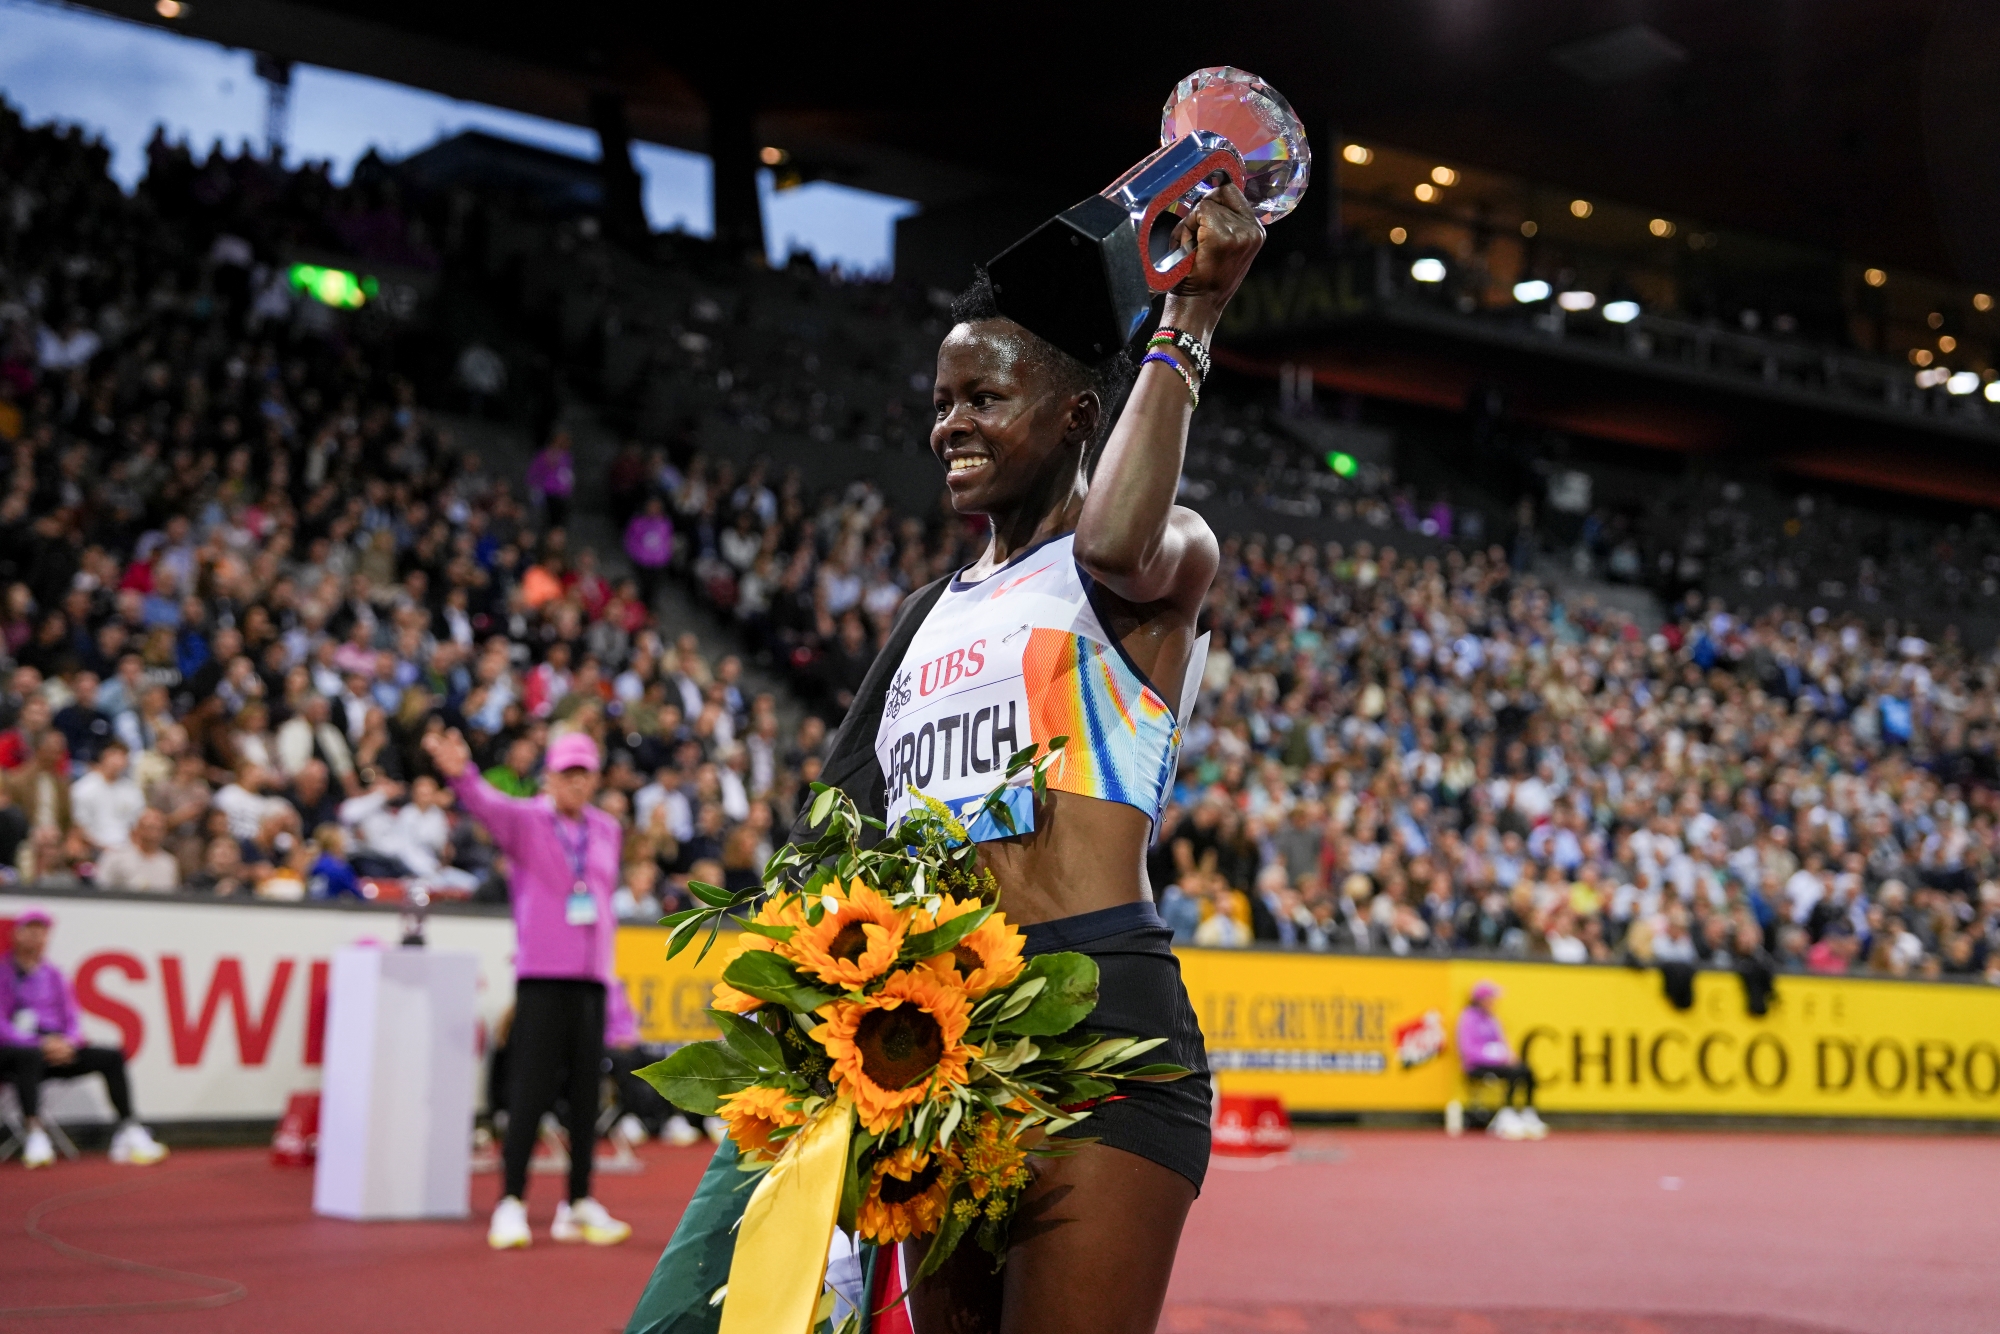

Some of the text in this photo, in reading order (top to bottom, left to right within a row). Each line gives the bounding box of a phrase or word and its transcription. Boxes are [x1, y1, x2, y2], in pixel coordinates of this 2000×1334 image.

[919, 639, 987, 697] UBS
[1203, 994, 1238, 1038] LE
[1250, 986, 1386, 1041] GRUYÈRE
[1521, 1026, 1789, 1095] CHICCO
[1815, 1034, 2000, 1097] D'ORO
